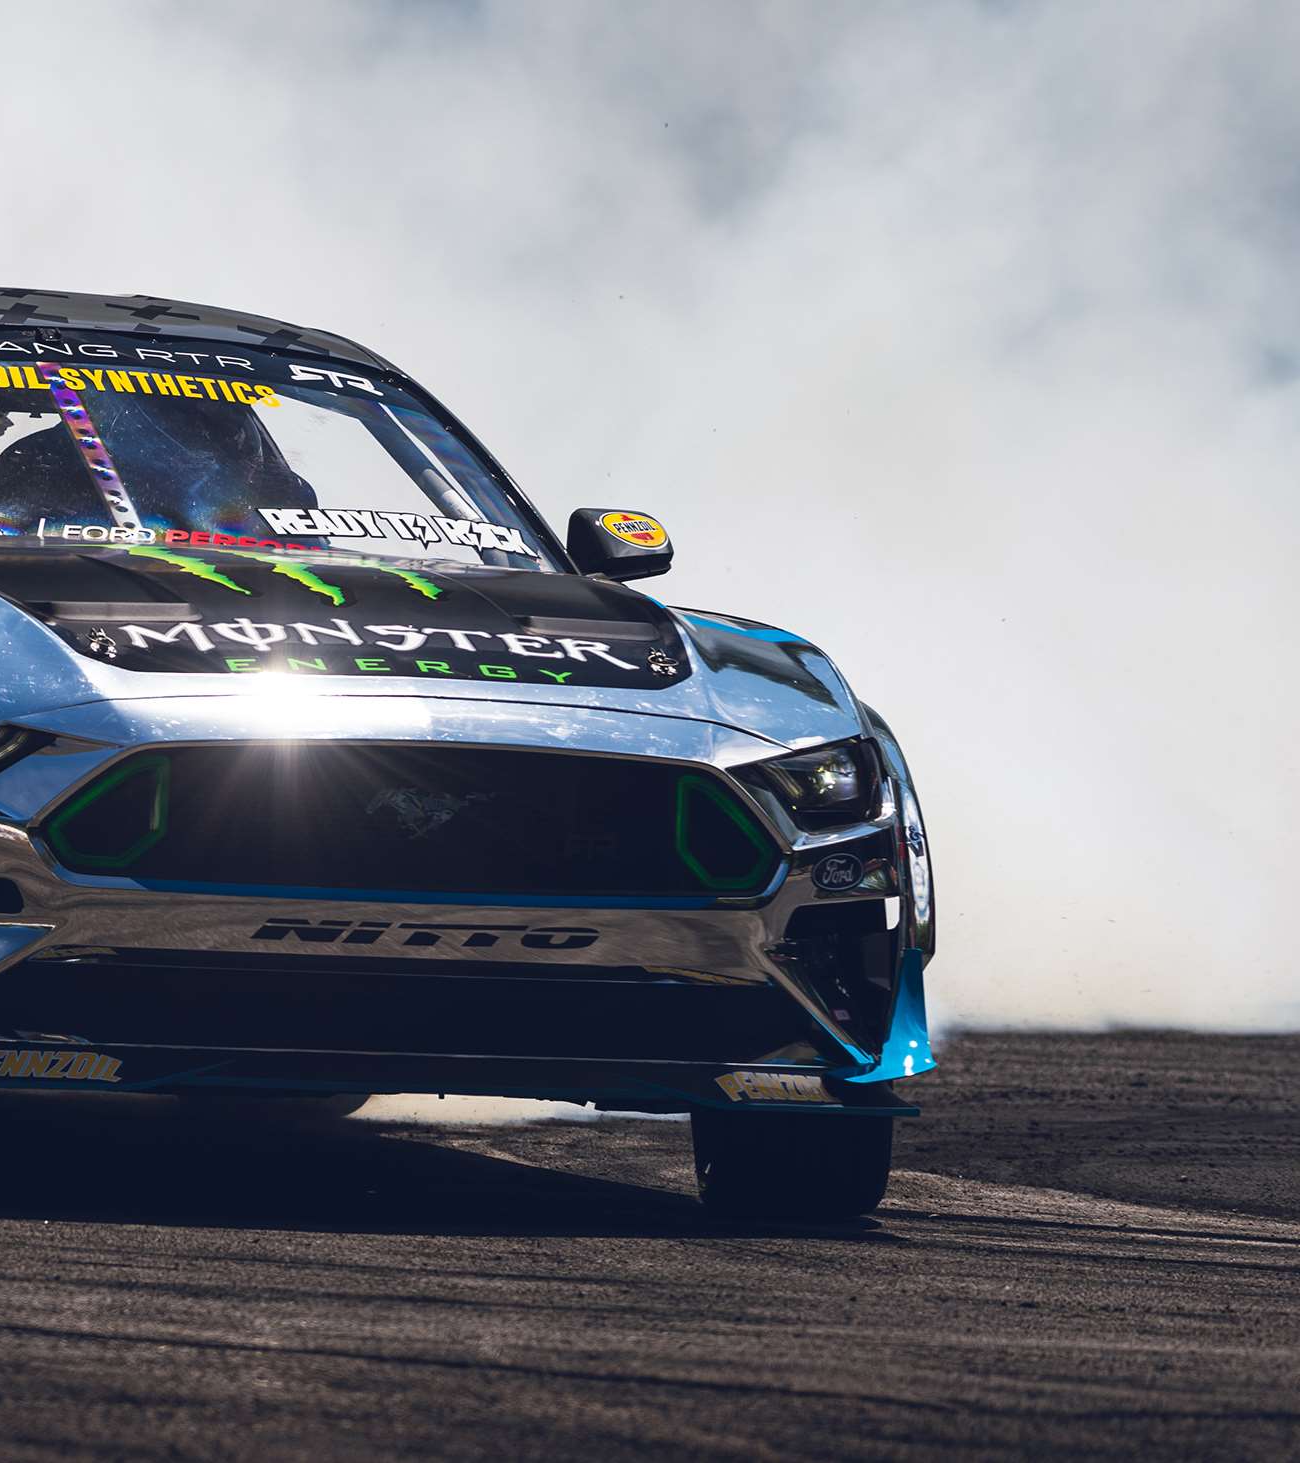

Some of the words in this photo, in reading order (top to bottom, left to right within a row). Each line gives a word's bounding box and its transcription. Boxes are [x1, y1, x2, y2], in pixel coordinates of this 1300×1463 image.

[136, 347, 255, 371] RTR
[65, 367, 284, 408] SYNTHETICS
[62, 523, 157, 544] FORD
[257, 507, 387, 539] READY
[377, 510, 442, 551] TO
[432, 514, 541, 559] ROCK
[117, 617, 640, 671] MONSTER
[225, 656, 573, 683] ENERGY
[821, 858, 854, 884] Ford
